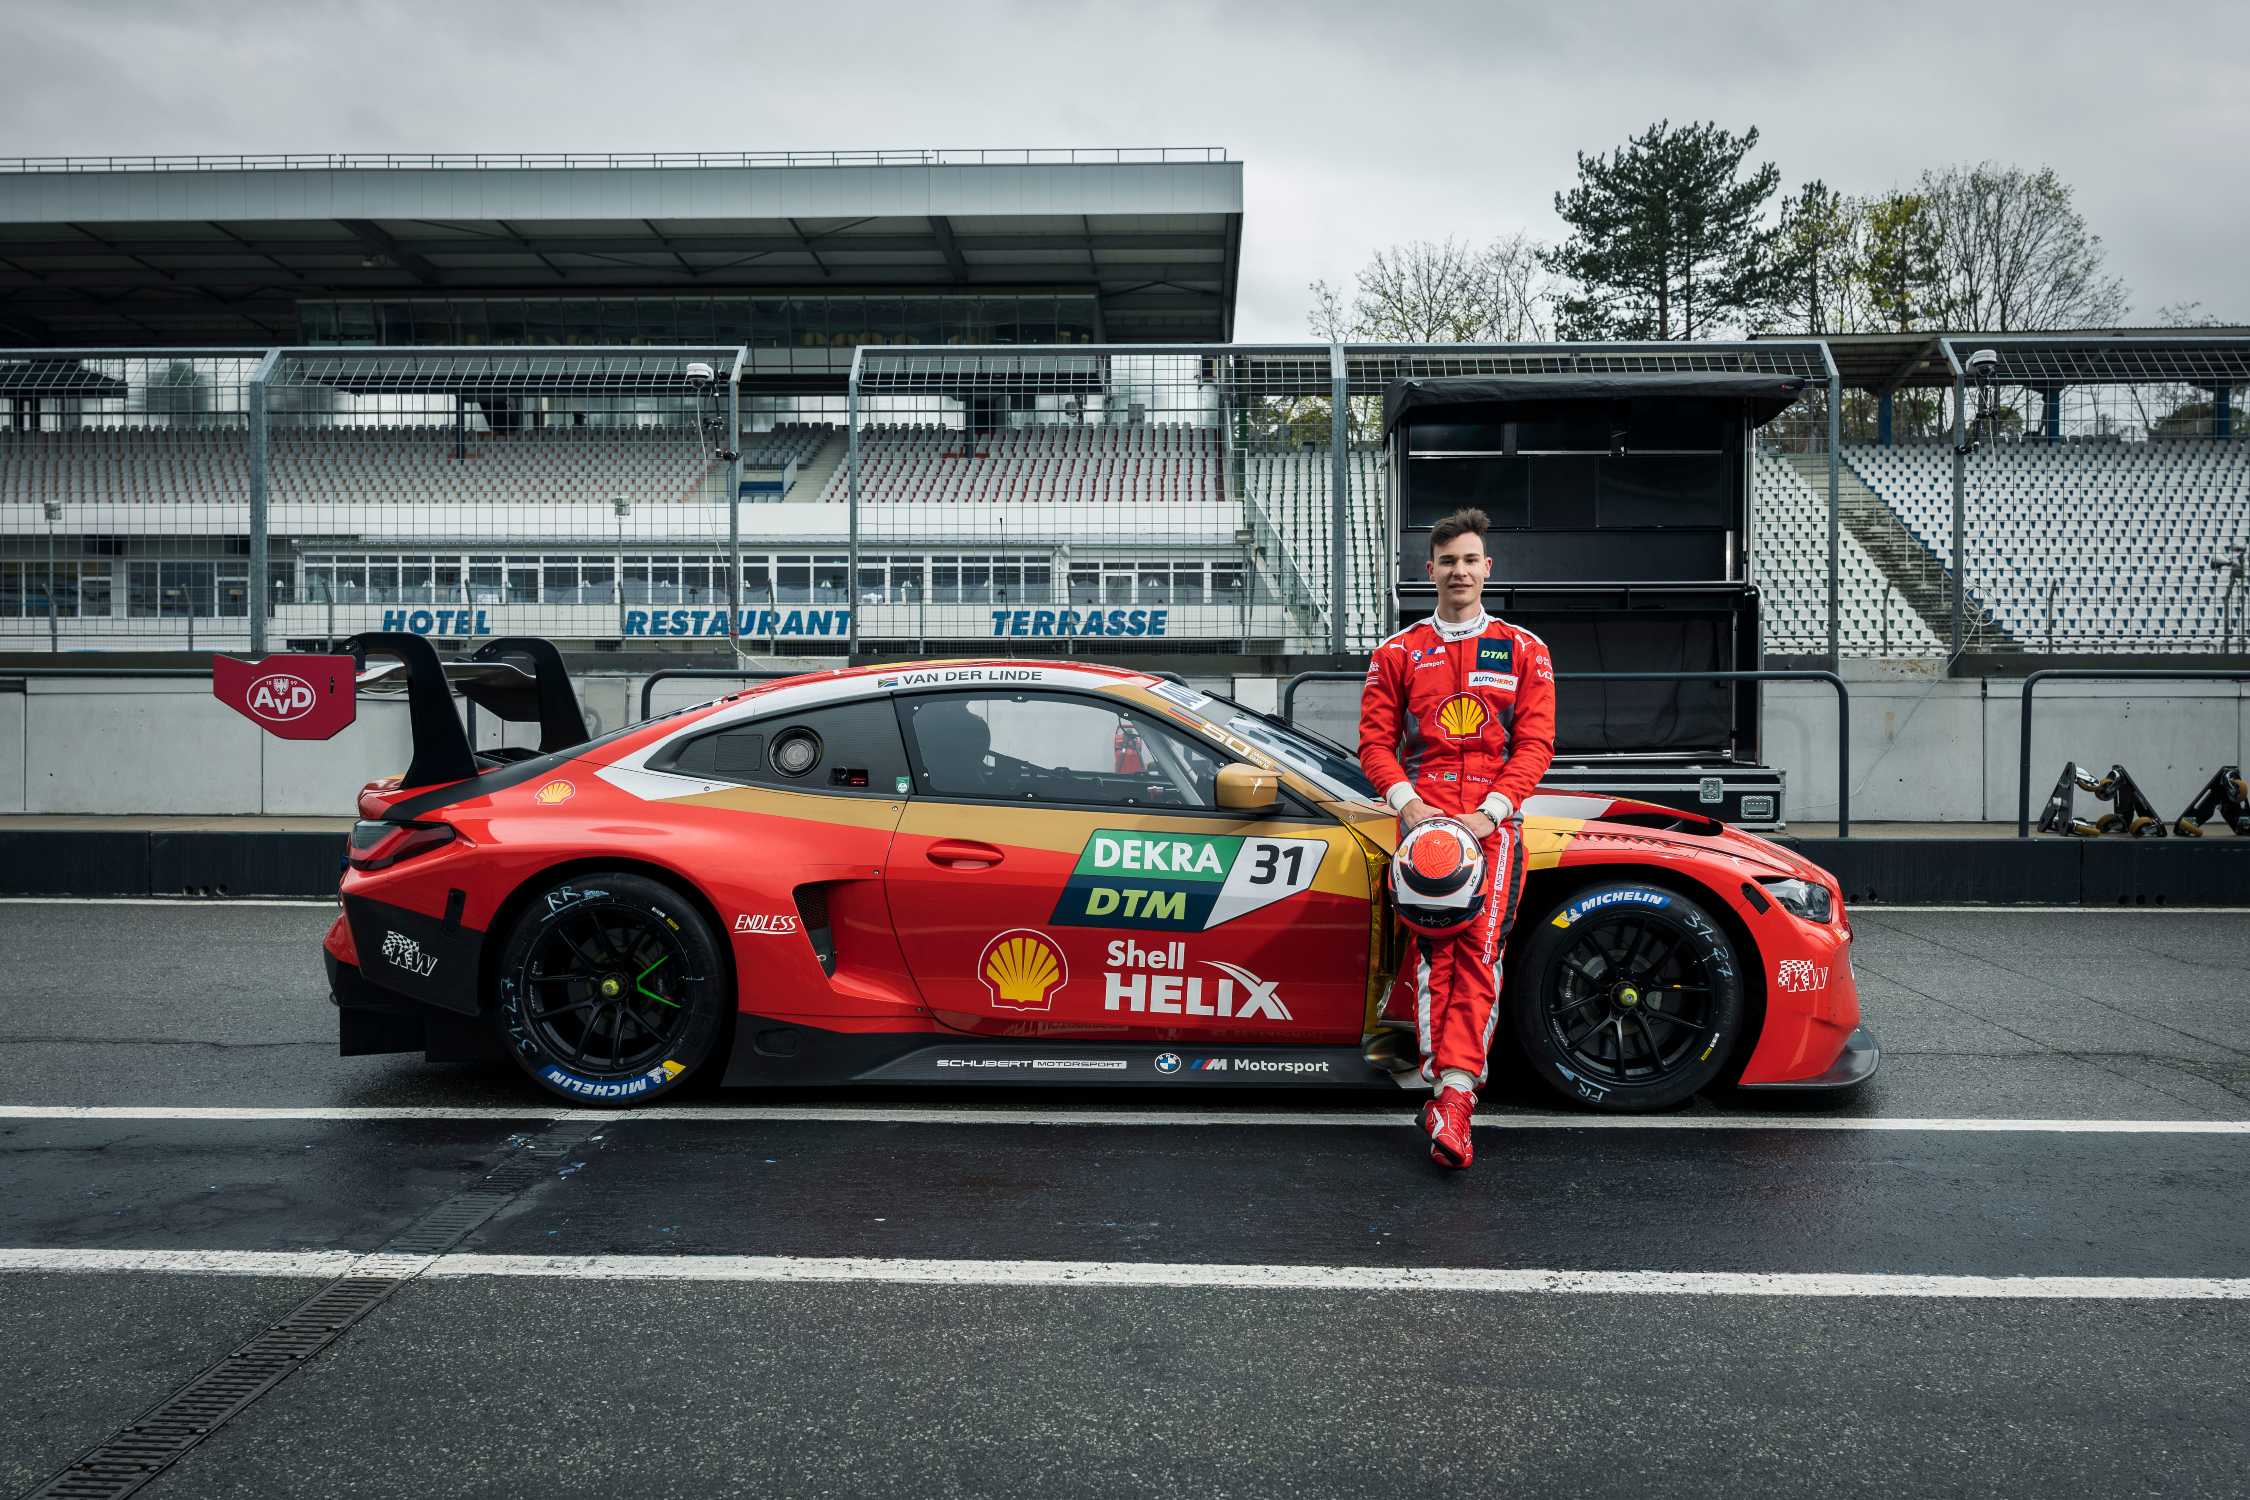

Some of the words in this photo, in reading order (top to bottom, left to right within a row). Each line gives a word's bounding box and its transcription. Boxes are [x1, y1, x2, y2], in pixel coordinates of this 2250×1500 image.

[383, 610, 491, 634] HOTEL
[625, 610, 851, 635] RESTAURANT
[991, 610, 1167, 635] TERRASSE
[1480, 650, 1509, 660] DTM
[903, 672, 939, 685] VAN
[945, 670, 982, 682] DER
[988, 670, 1042, 681] LINDE
[1472, 676, 1514, 686] AUTOHERO
[1093, 838, 1223, 874] DEKRA
[1249, 844, 1304, 886] 31
[1085, 887, 1187, 920] DTM
[1581, 891, 1663, 912] MICHELIN
[733, 914, 798, 931] ENDLESS
[1481, 891, 1501, 965] SCHUBERT
[389, 943, 438, 977] KW
[1106, 939, 1186, 970] Shell
[1103, 960, 1293, 1021] HELIX
[1786, 966, 1829, 993] KW
[936, 1059, 1032, 1068] SCHUBERT
[1034, 1060, 1126, 1069] MOTORSPORT
[1234, 1058, 1330, 1074] Motorsport
[549, 1070, 647, 1096] MICHELIN
